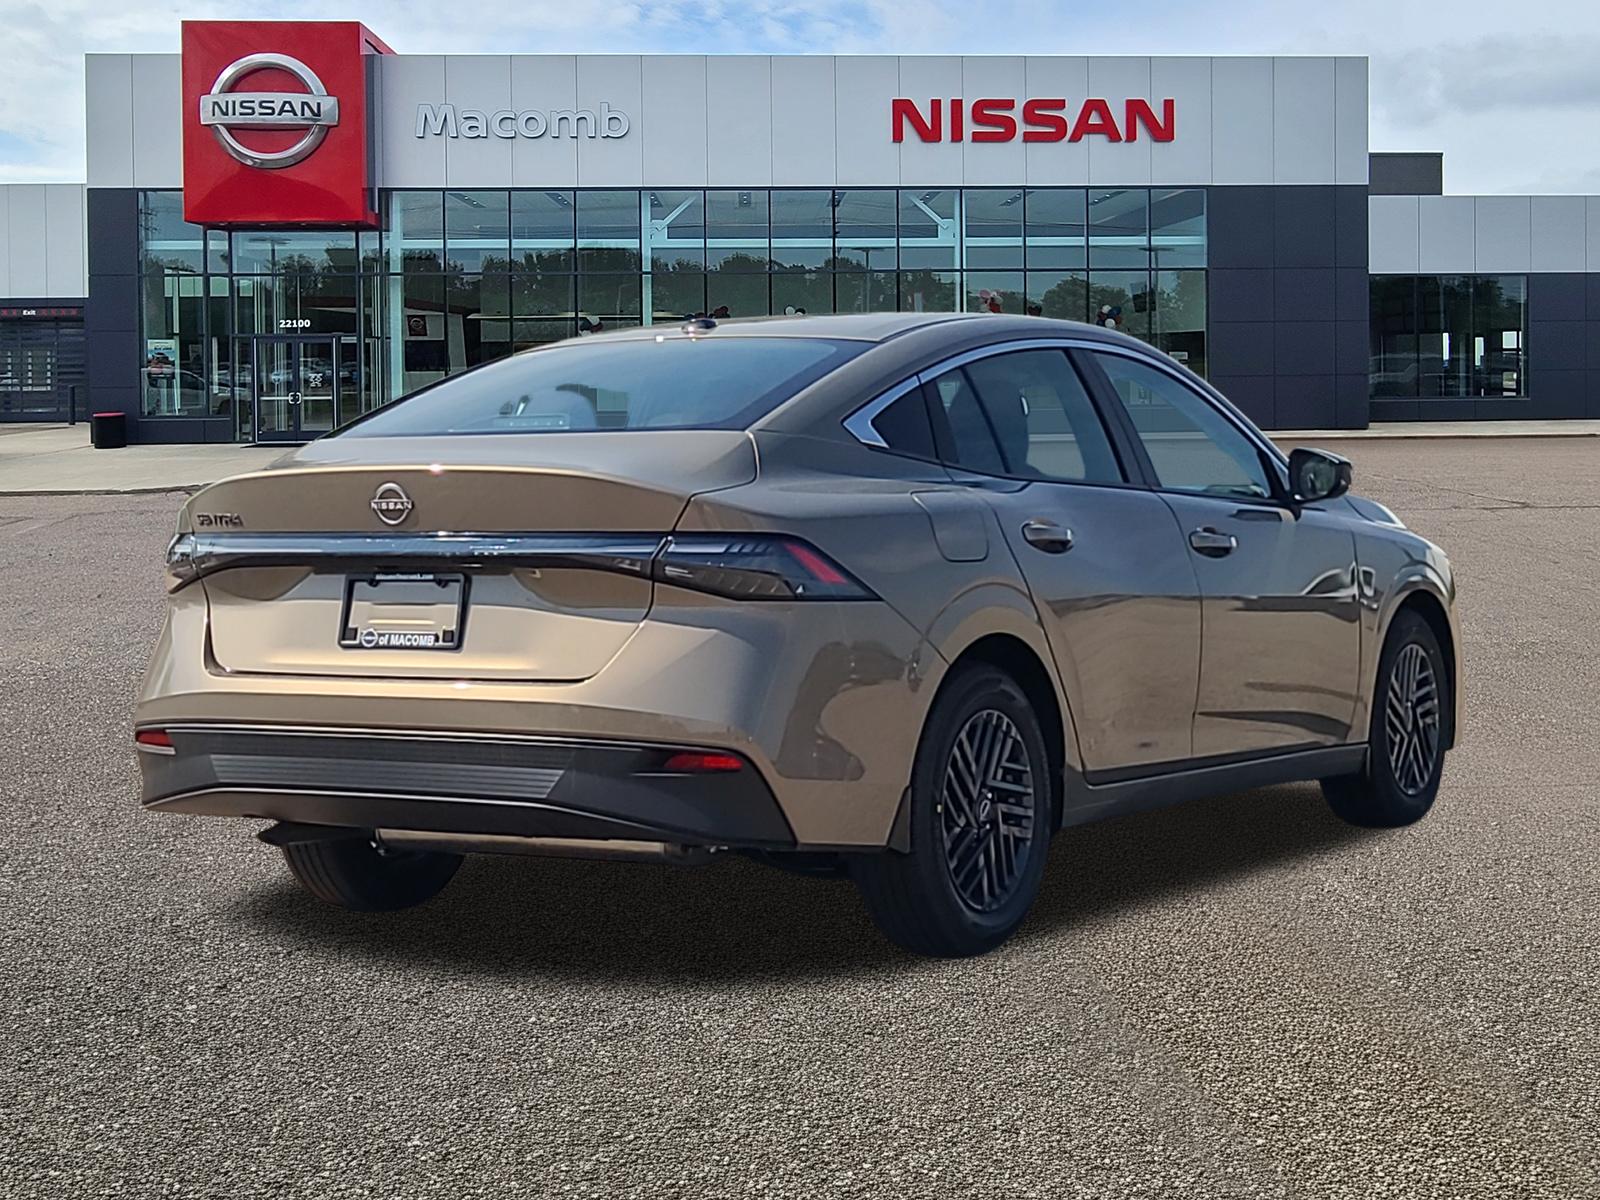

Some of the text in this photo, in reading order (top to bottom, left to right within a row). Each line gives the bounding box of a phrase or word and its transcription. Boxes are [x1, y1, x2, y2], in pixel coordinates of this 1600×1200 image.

[212, 99, 322, 118] NISSAN
[415, 101, 630, 139] Macomb
[892, 98, 1175, 143] NISSAN
[279, 319, 311, 328] 22100
[371, 502, 412, 510] NISSAN
[379, 634, 435, 646] of MACOMB
